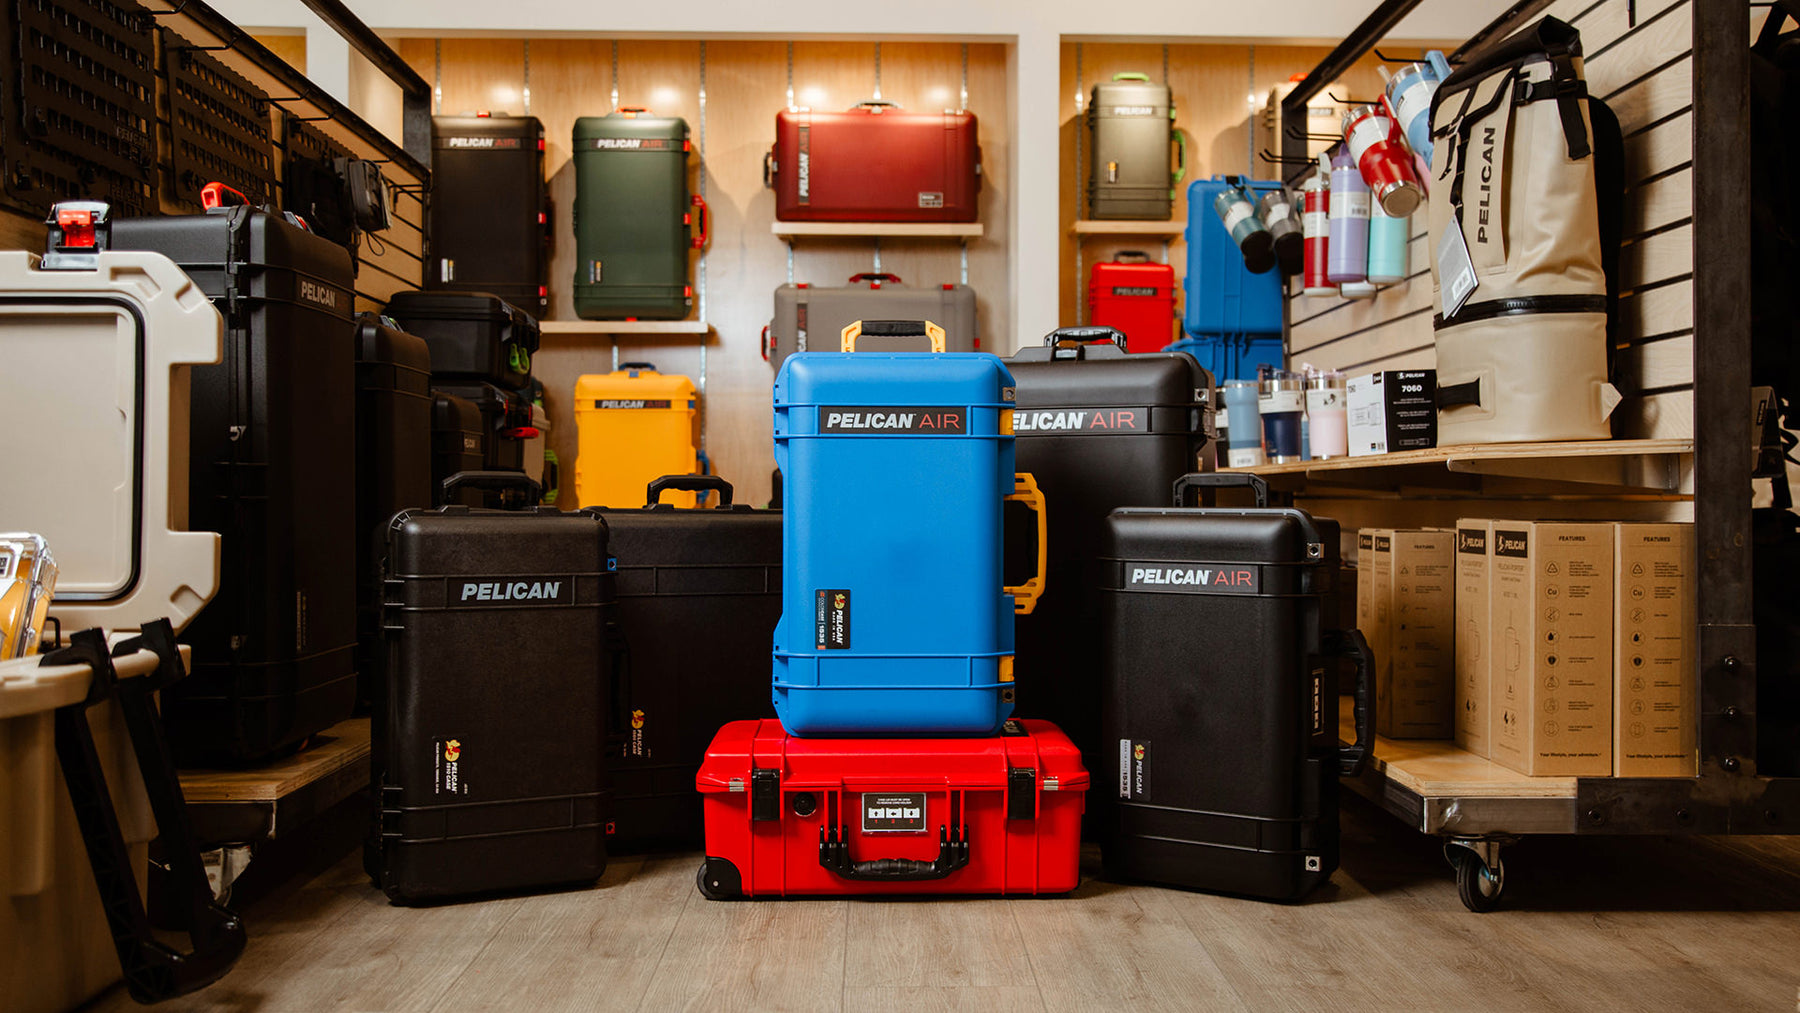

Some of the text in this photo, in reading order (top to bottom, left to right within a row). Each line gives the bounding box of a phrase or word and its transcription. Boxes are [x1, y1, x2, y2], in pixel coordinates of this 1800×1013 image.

[1113, 107, 1153, 116] PELICAN
[449, 137, 517, 148] PELICAN AIR
[597, 138, 664, 149] PELICAN AIR
[799, 153, 809, 197] PELICAN
[1477, 127, 1496, 244] PELICAN
[301, 281, 336, 308] PELICAN
[1116, 288, 1153, 297] PELICAN
[1401, 385, 1423, 393] 7060
[602, 400, 667, 408] PELICAN AIR
[827, 412, 960, 429] PELICAN AIR
[1013, 411, 1135, 430] ELICAN AIR
[1467, 537, 1485, 548] PELICAN
[1505, 540, 1526, 551] PELICAN
[1131, 568, 1252, 586] PELICAN AIR
[461, 581, 561, 600] PELICAN
[836, 609, 844, 644] PELICAN
